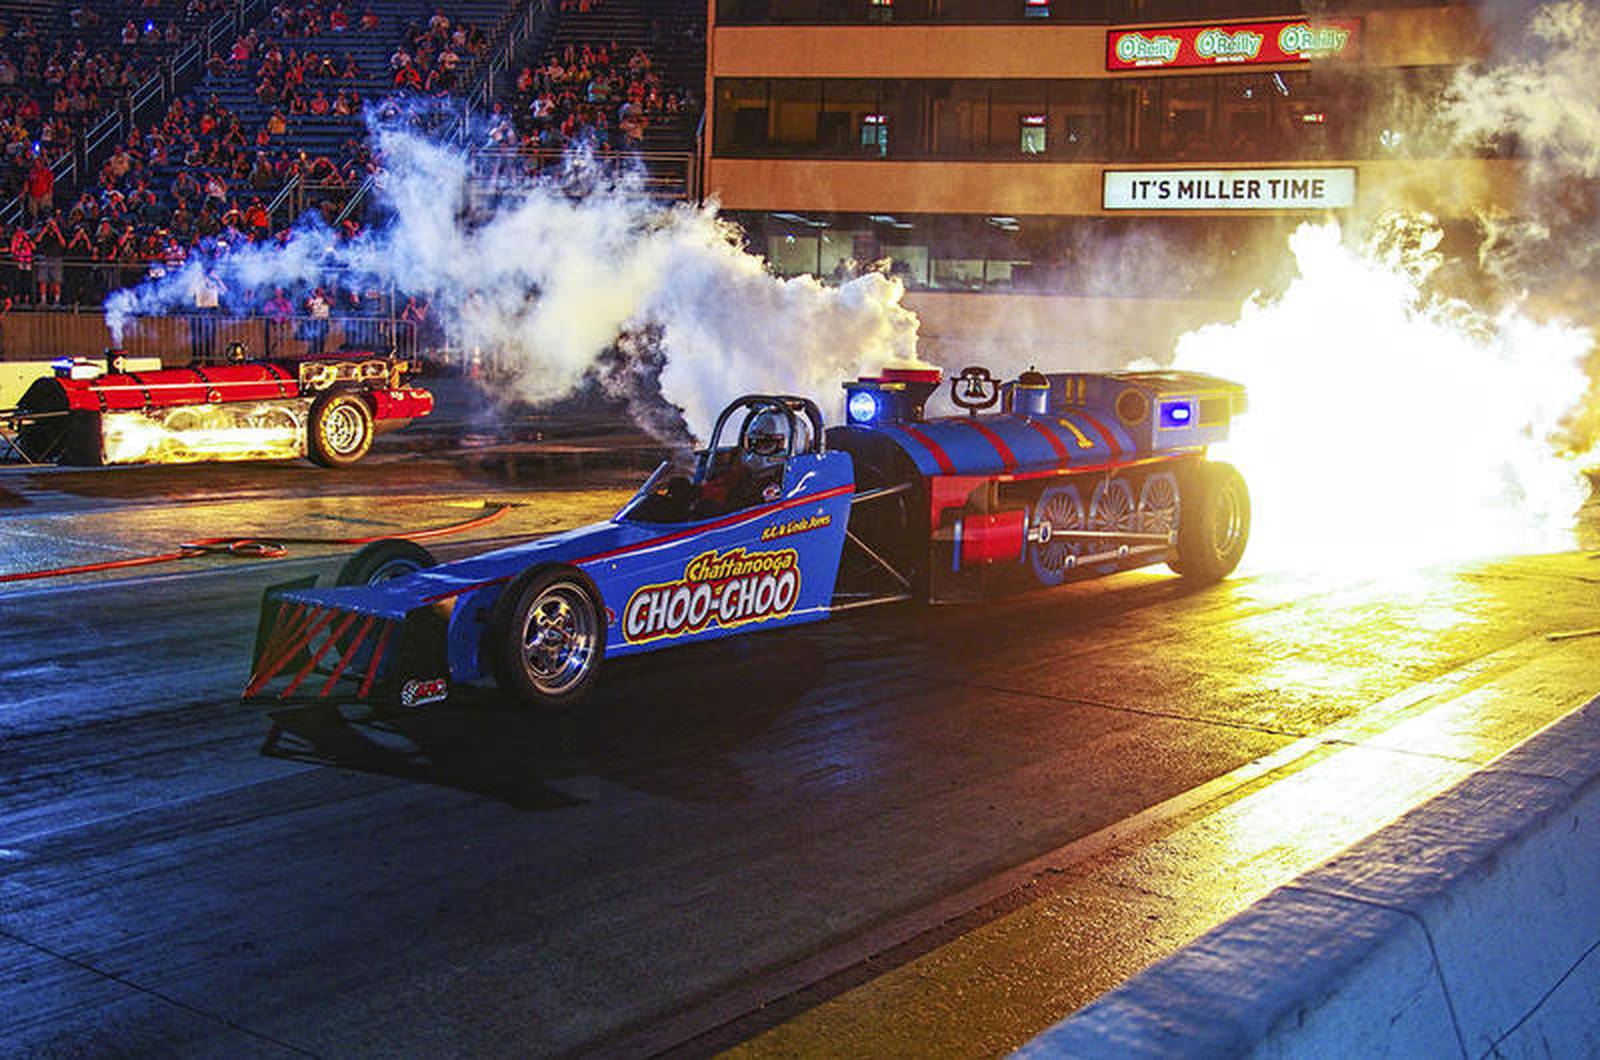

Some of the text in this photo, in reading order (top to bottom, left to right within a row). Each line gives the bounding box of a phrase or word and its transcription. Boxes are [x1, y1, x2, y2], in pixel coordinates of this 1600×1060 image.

[1117, 33, 1182, 61] O'Reilly
[1196, 29, 1263, 58] O'Reilly
[1131, 179, 1325, 200] IT'S MILLER TIME
[688, 556, 792, 582] Chattanooga
[627, 571, 795, 635] CHOO-CHOO
